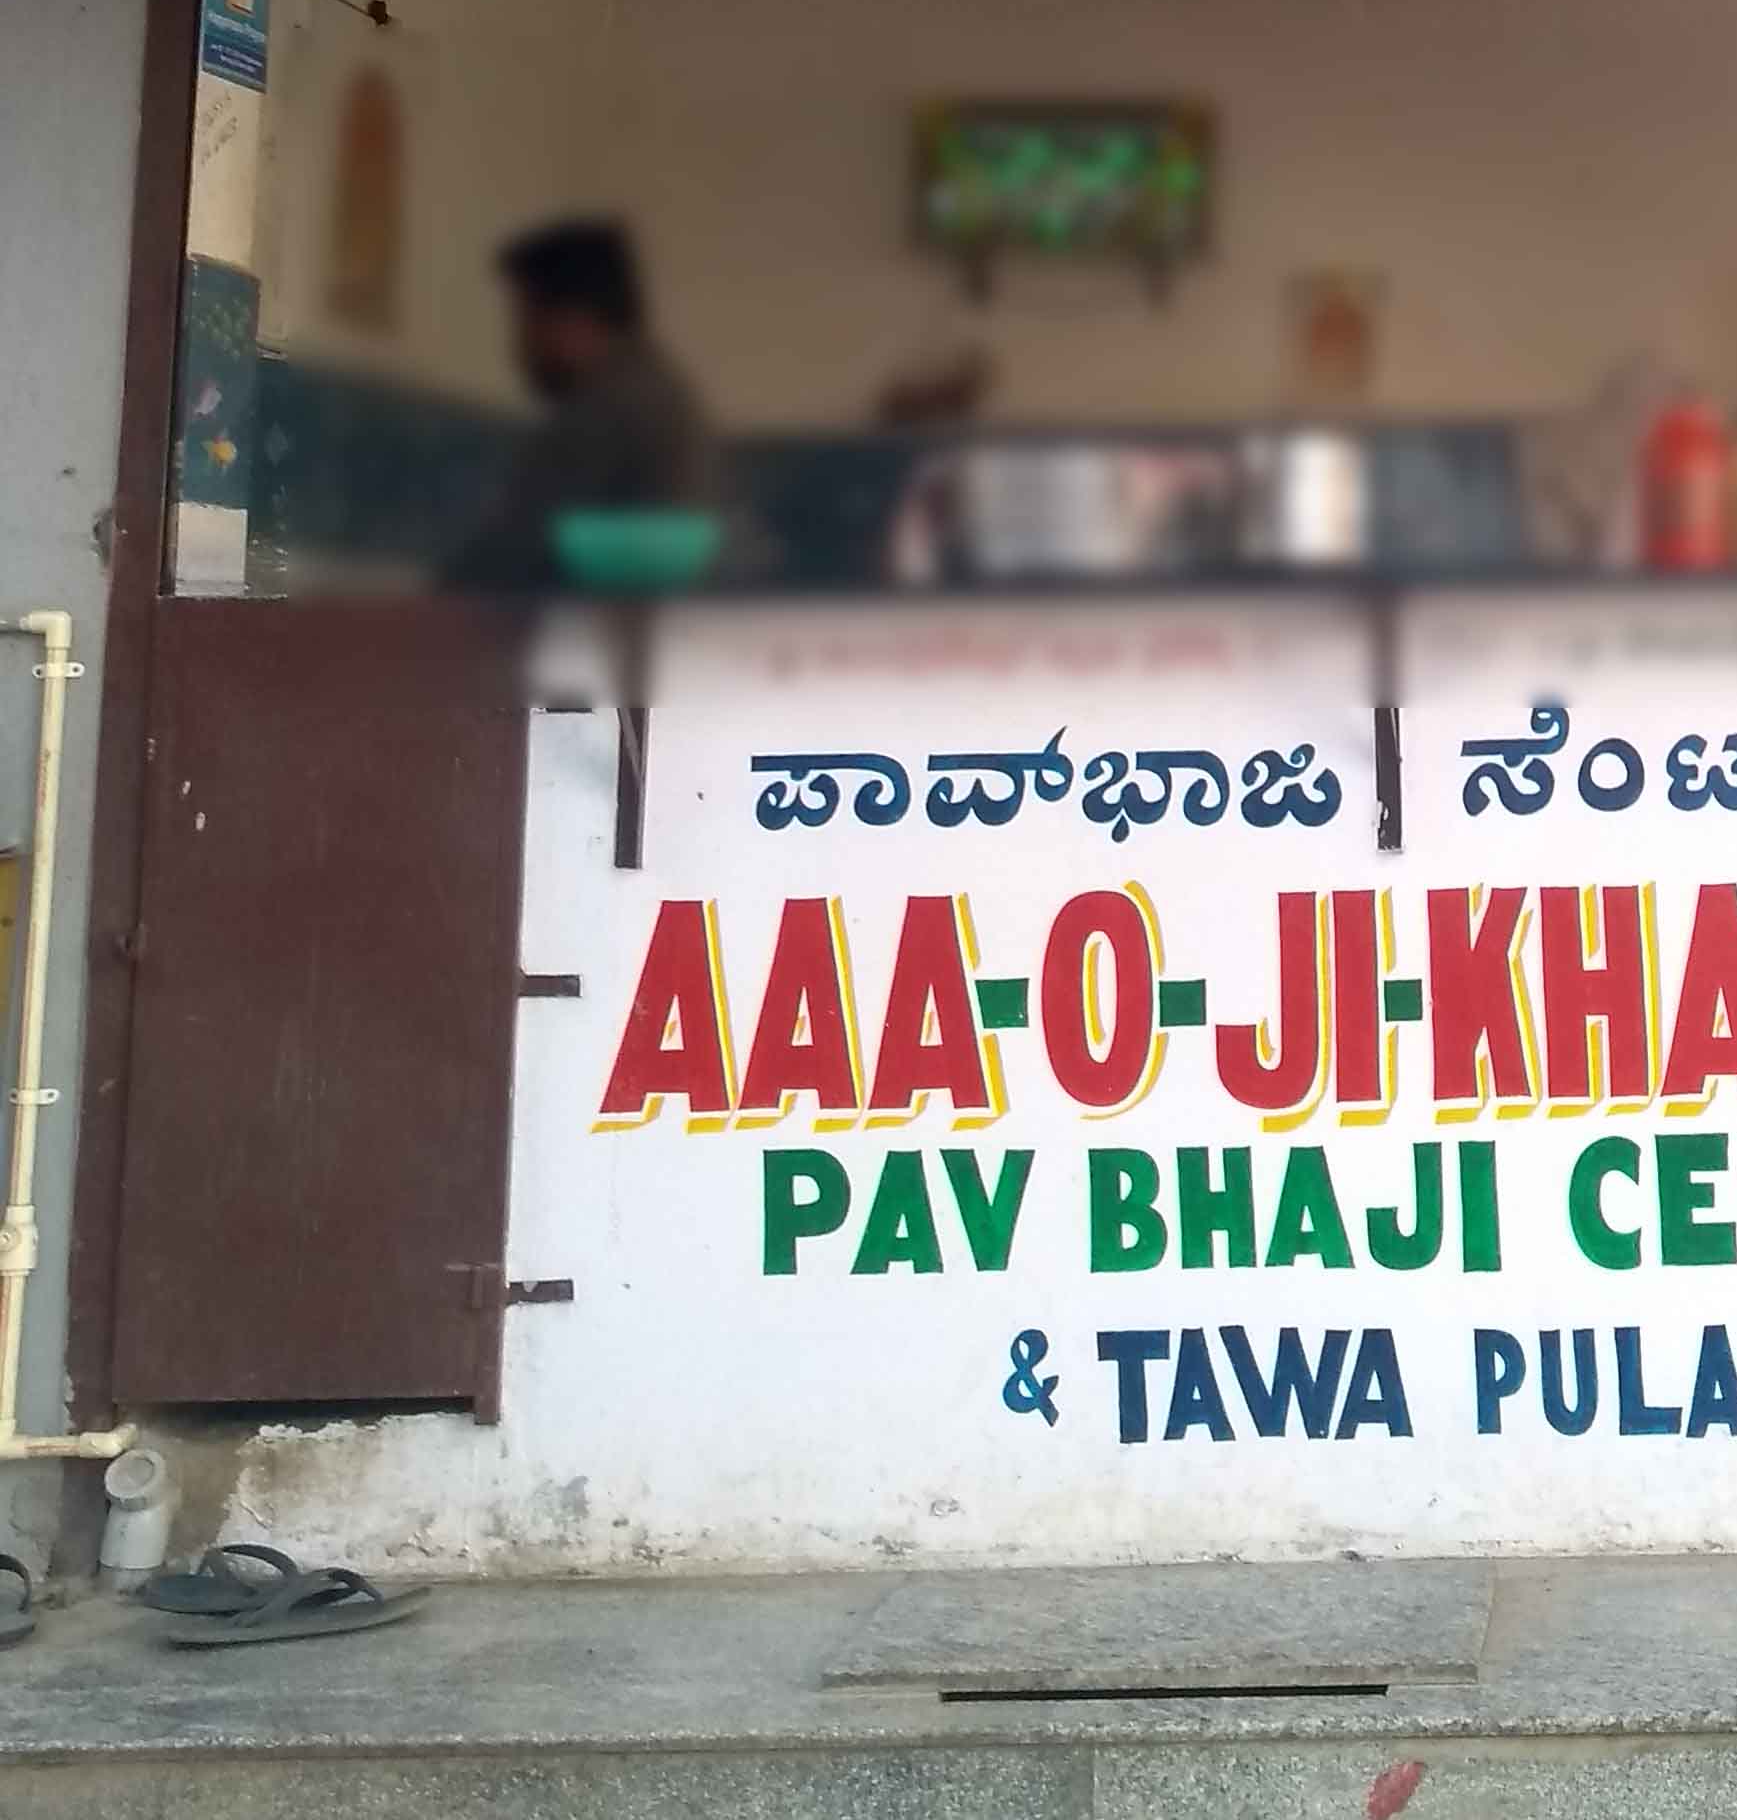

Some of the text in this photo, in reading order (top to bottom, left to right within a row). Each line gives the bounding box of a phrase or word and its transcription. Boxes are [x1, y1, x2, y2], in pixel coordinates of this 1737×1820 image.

[762, 1149, 1035, 1276] PAV
[1087, 1139, 1502, 1274] BHAJI
[1001, 1328, 1060, 1426] &
[1096, 1324, 1414, 1444] TAWA
